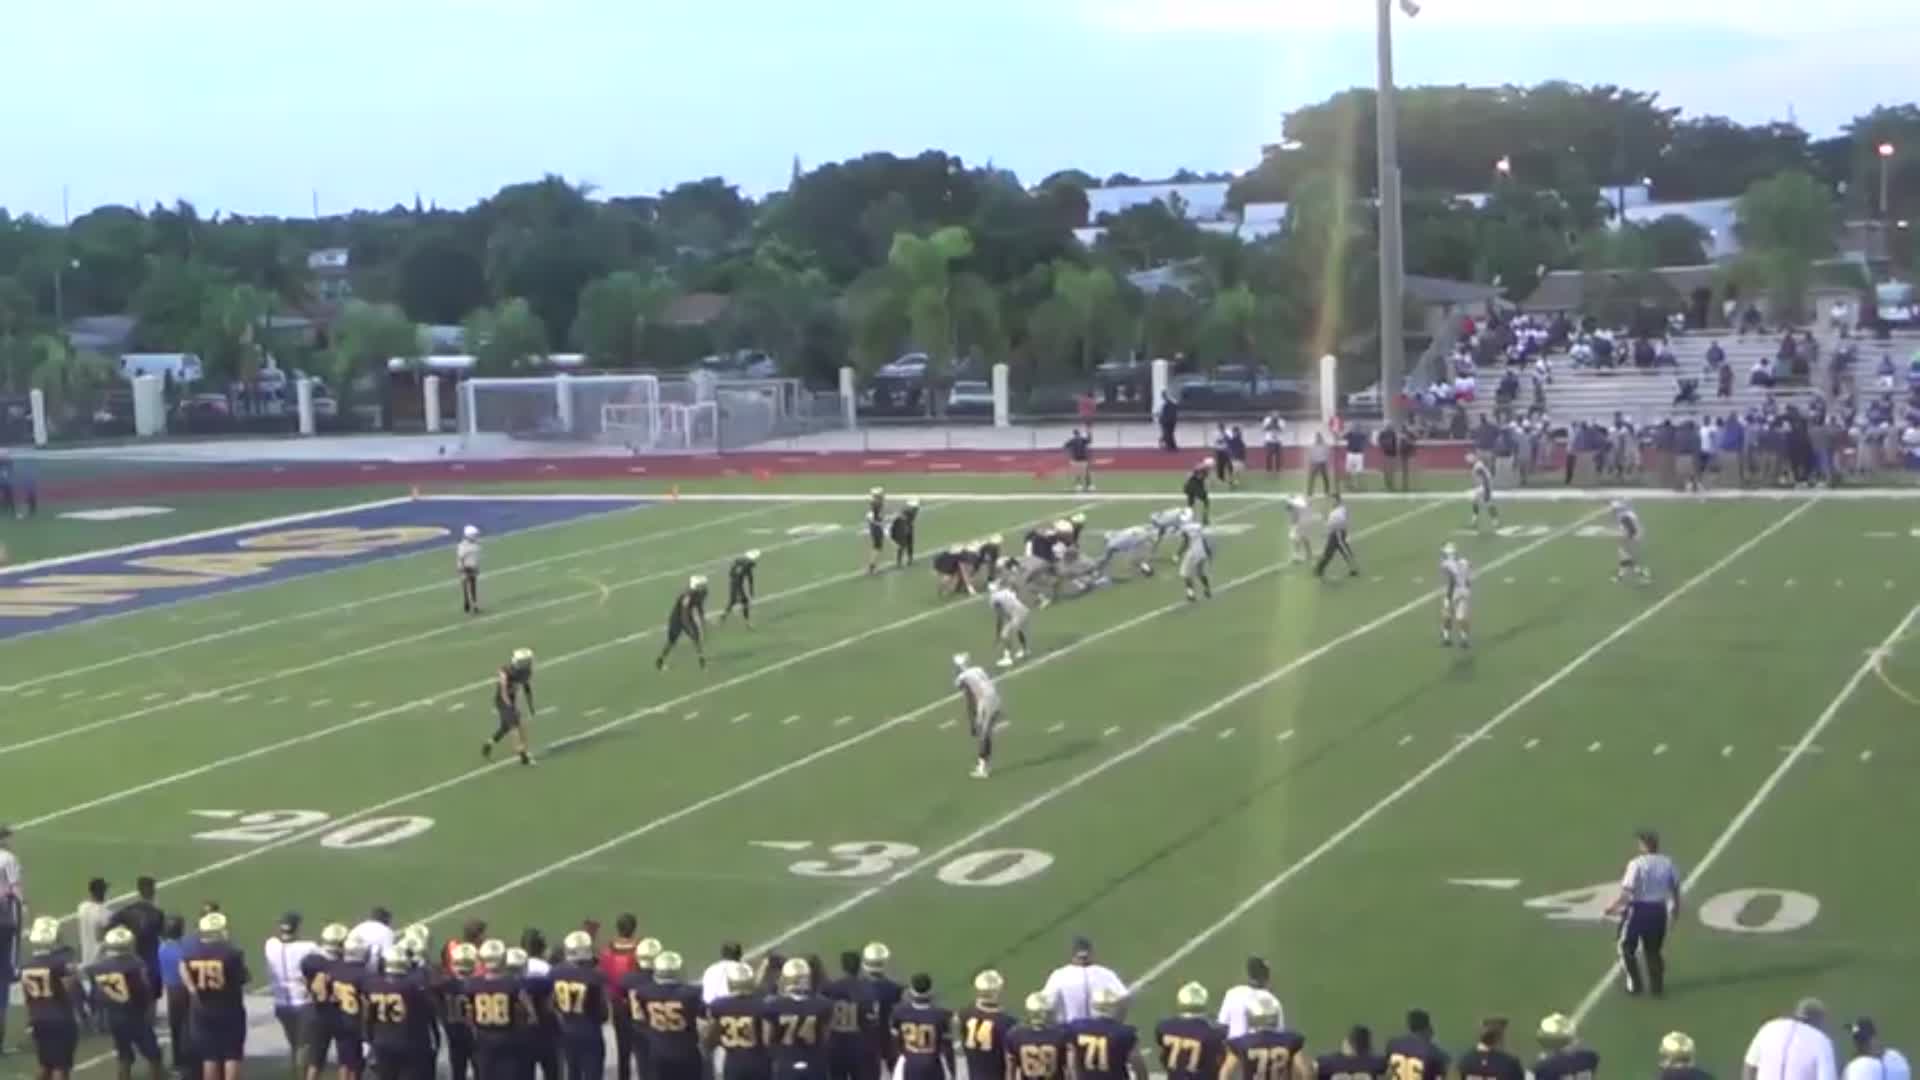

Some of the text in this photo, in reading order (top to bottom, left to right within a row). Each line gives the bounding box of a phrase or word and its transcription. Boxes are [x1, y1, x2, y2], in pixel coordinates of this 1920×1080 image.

[192, 809, 436, 849] 20
[788, 841, 1055, 886] 30
[369, 992, 406, 1023] 73
[474, 991, 510, 1025] 88
[718, 1015, 753, 1048] 33
[778, 1014, 817, 1046] 74
[965, 1016, 995, 1051] 14
[1077, 1033, 1109, 1070] 71
[1162, 1035, 1202, 1073] 77
